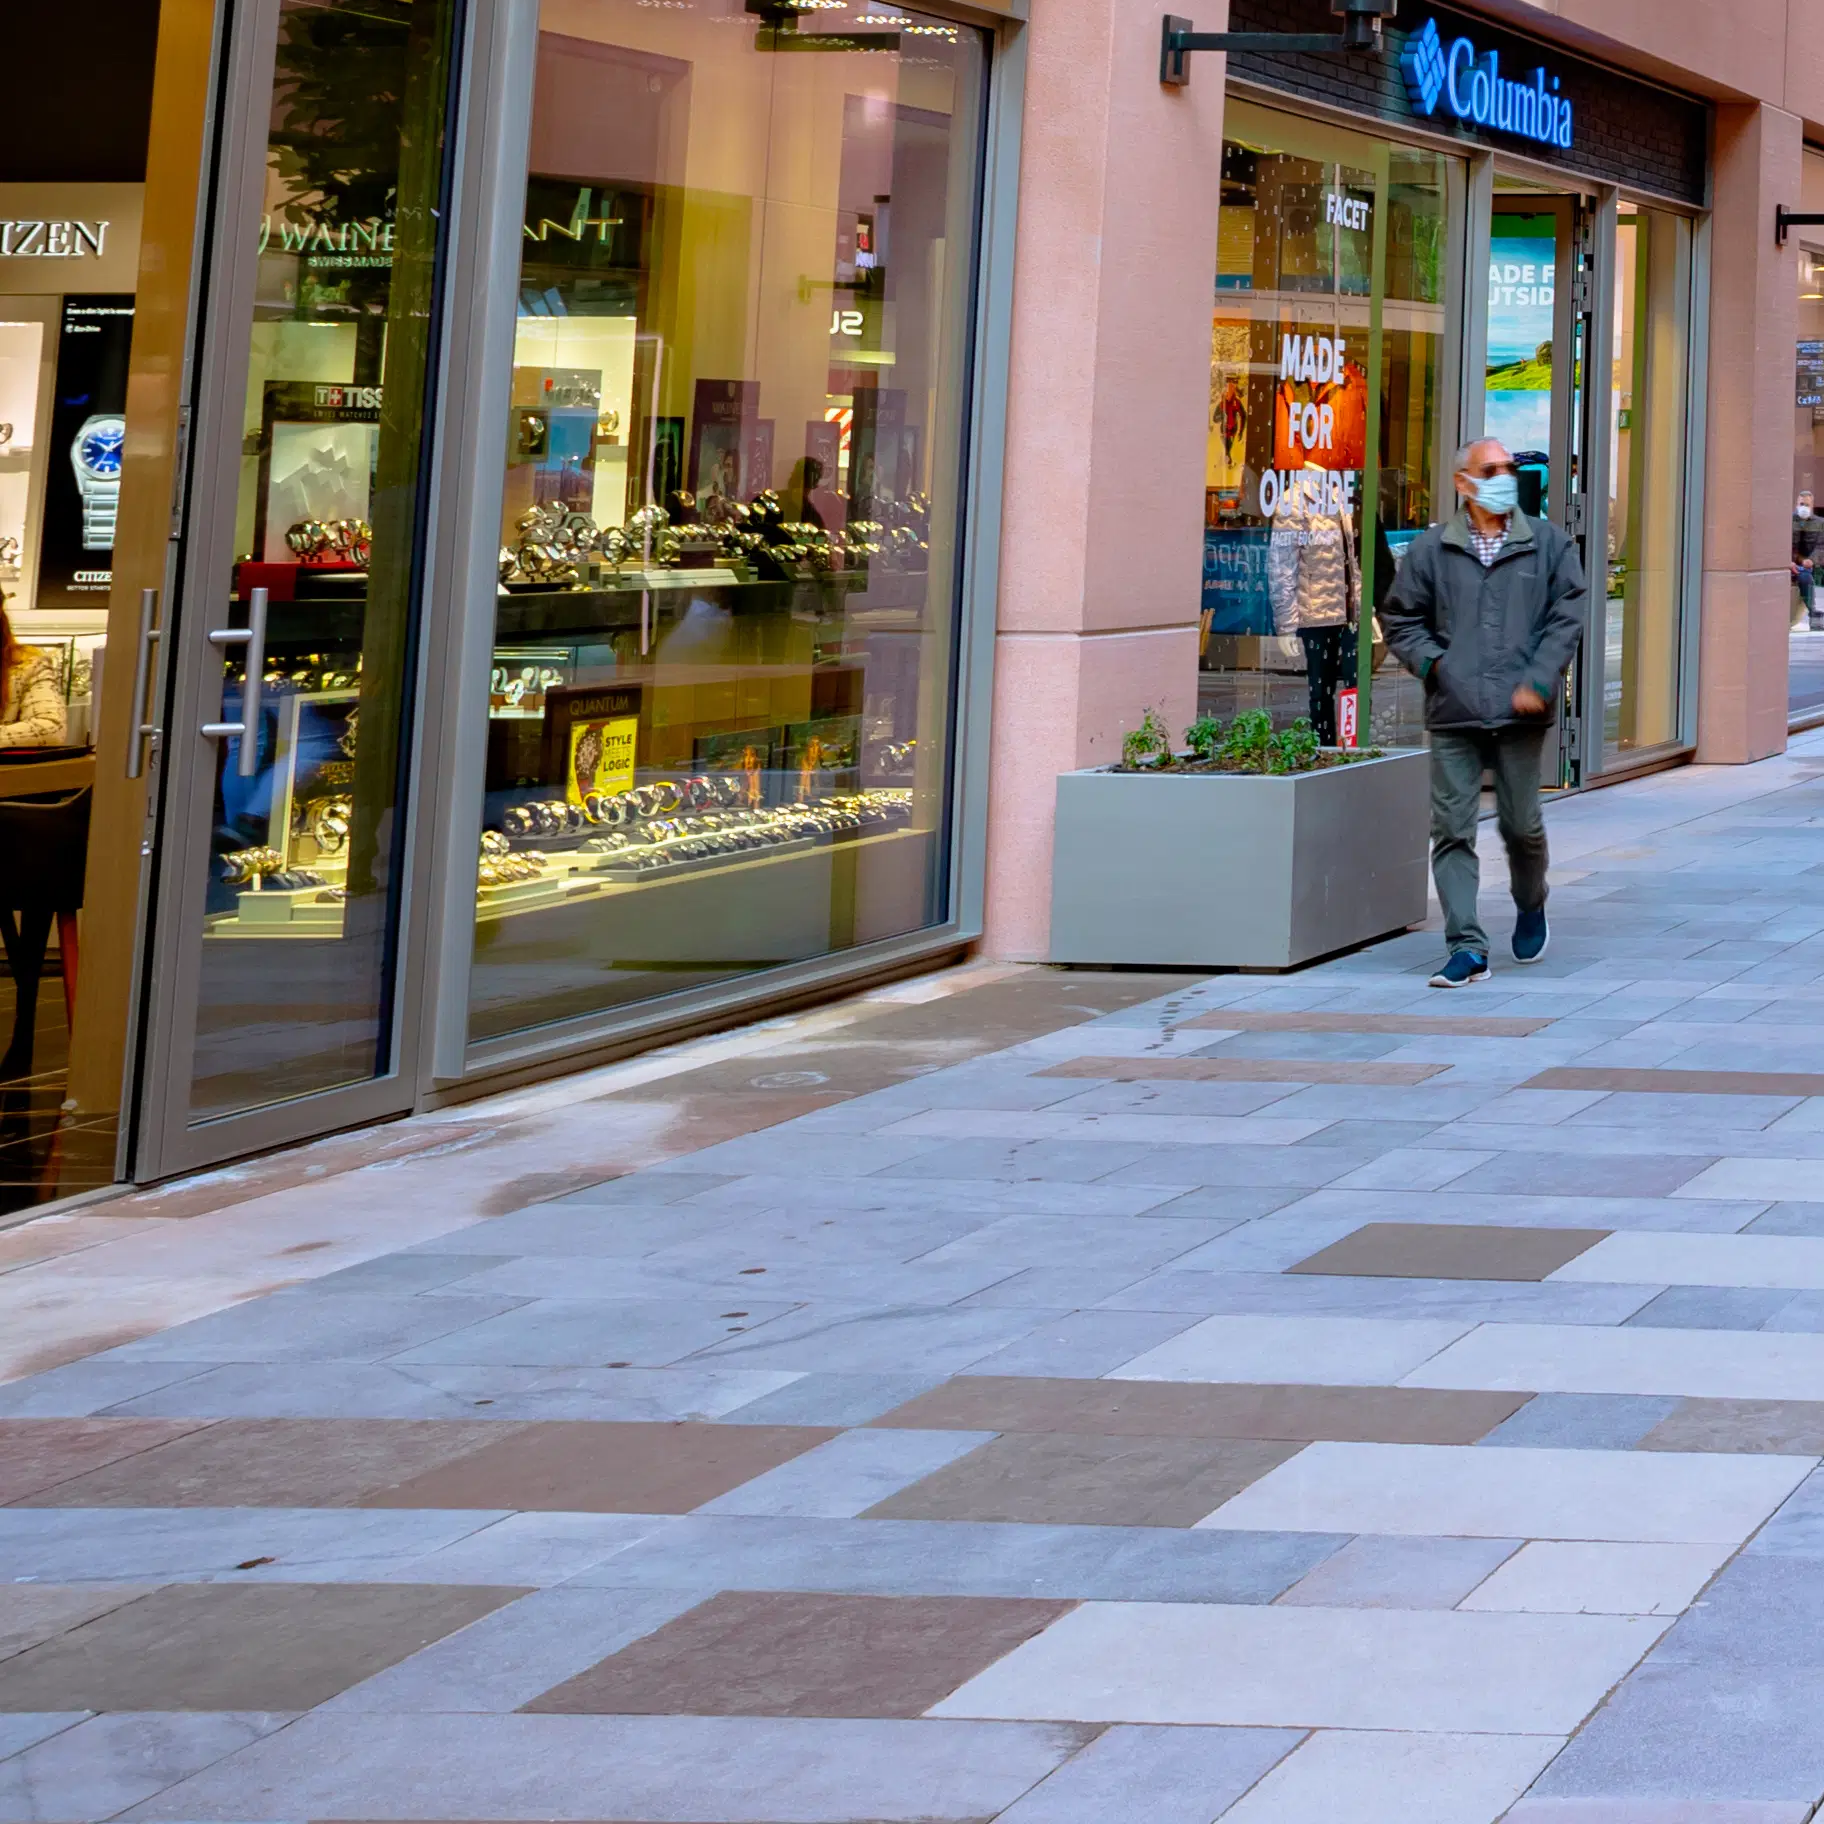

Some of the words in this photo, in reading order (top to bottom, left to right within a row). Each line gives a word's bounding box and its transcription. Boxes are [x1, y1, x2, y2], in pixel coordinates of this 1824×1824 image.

[1447, 38, 1574, 149] Columbia
[1326, 194, 1369, 231] FACET
[1280, 334, 1346, 385] MADE
[1287, 402, 1335, 450] FOR
[1260, 469, 1356, 519] OUTSIDE
[570, 696, 629, 716] QUANTUM
[605, 734, 632, 747] STYLE
[603, 758, 630, 772] LOGIC
